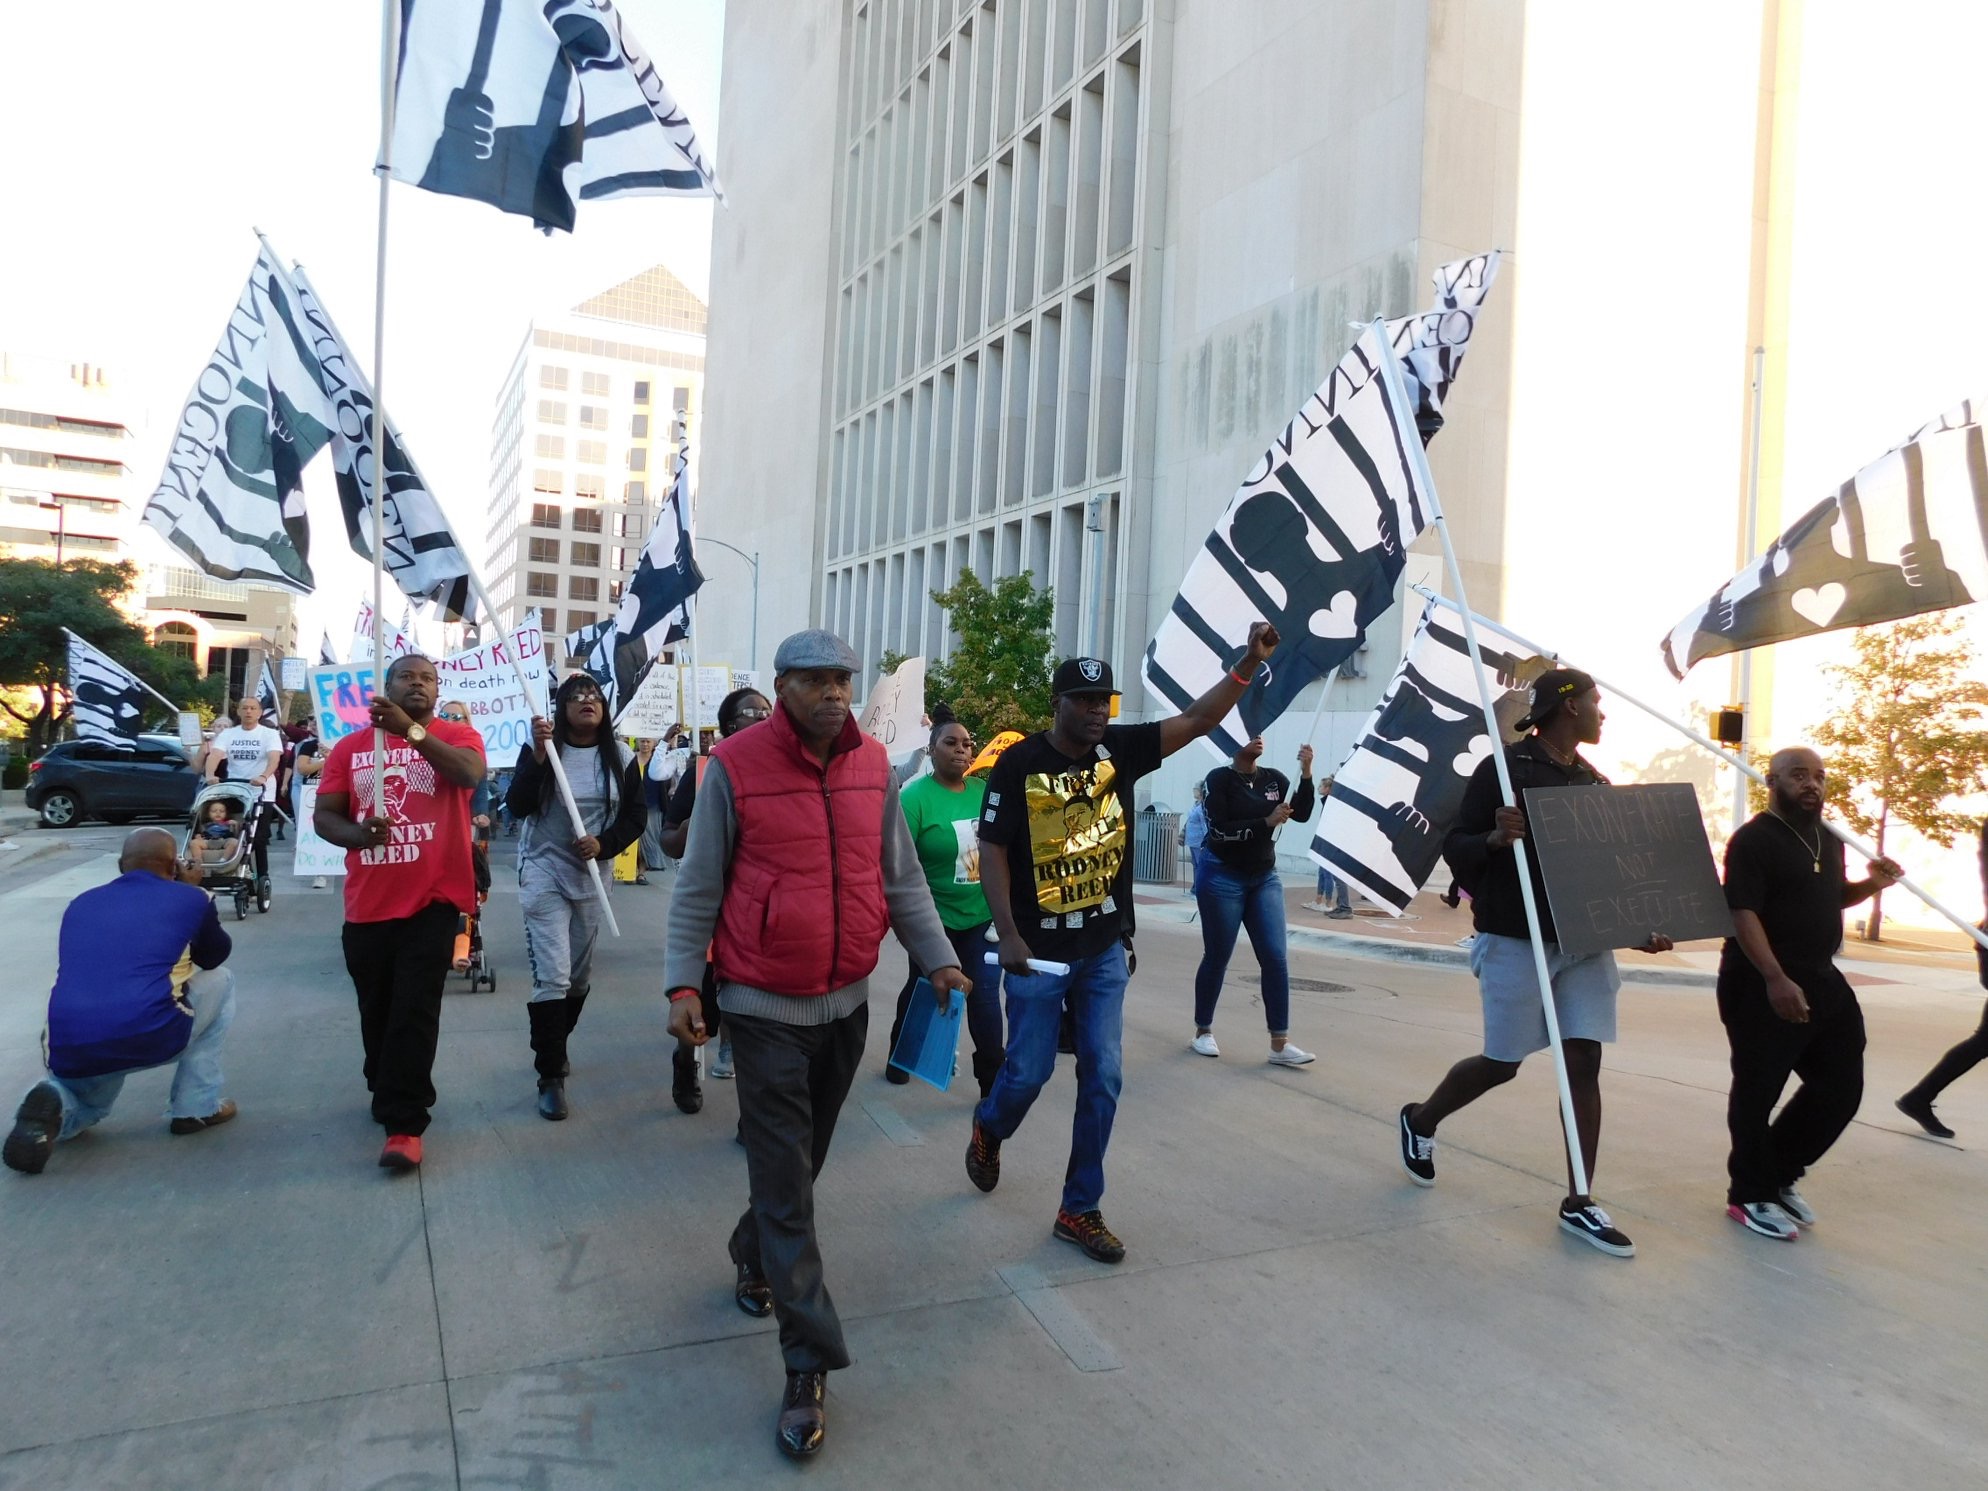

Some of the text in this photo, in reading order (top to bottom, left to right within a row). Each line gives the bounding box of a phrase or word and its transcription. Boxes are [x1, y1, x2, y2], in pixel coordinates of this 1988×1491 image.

[492, 628, 541, 666] RED
[315, 669, 387, 707] FRE
[459, 674, 505, 689] death
[512, 669, 540, 684] rw
[464, 693, 527, 716] BBOTT
[231, 739, 261, 747] JUSTICE
[388, 822, 436, 844] NEY
[1537, 791, 1697, 847] EXONERATE
[1038, 845, 1124, 881] RODNEY
[1615, 852, 1655, 880] NOT
[1586, 892, 1704, 934] EXECUTE
